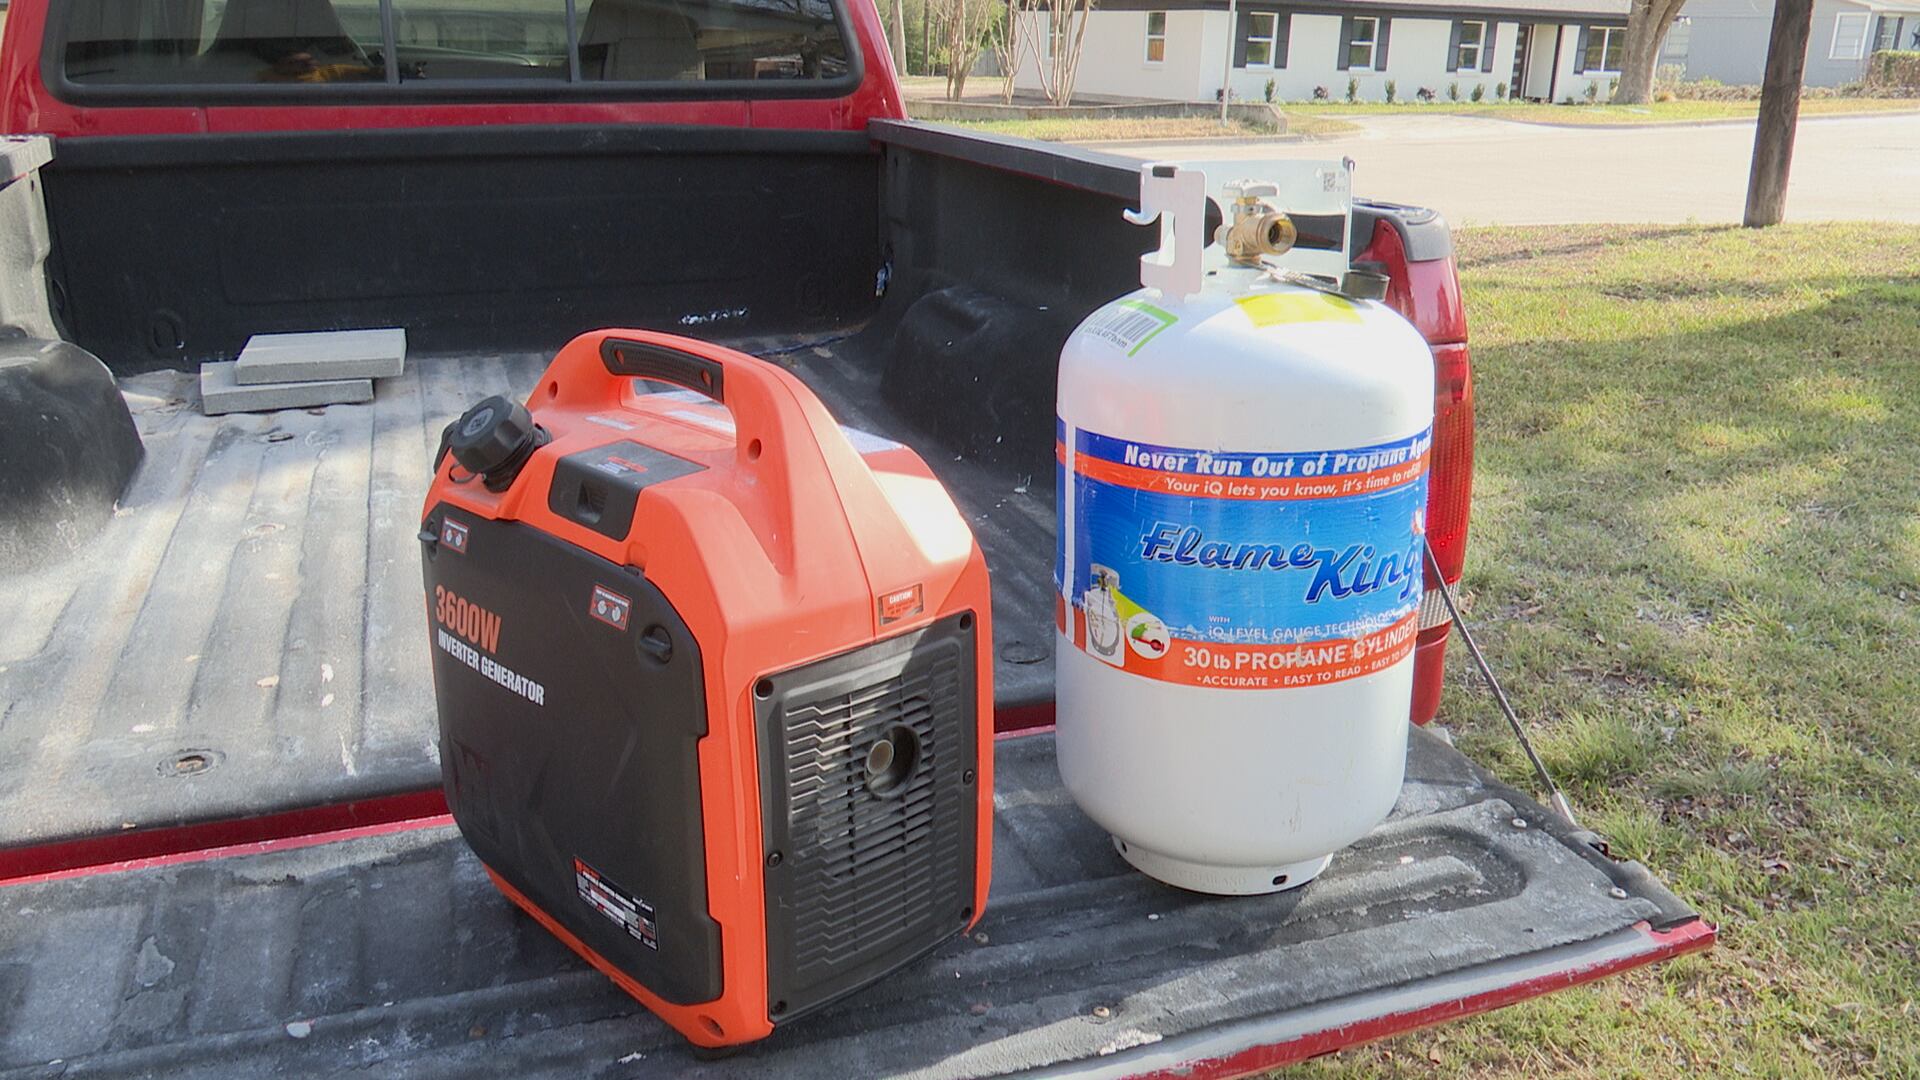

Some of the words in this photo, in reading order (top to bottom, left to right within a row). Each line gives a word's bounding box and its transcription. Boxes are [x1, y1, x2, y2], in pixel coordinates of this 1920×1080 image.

[1124, 444, 1188, 471] Never
[1196, 453, 1243, 475] Run
[1252, 456, 1295, 477] Out
[1302, 453, 1328, 476] of
[1332, 446, 1407, 474] Propane
[1165, 477, 1200, 492] Your
[1204, 481, 1223, 495] iQ
[1228, 482, 1255, 496] lets
[1260, 484, 1289, 499] you
[1294, 482, 1338, 496] know,
[1342, 480, 1362, 493] it's
[1366, 475, 1390, 488] time
[1392, 472, 1401, 483] to
[1141, 520, 1320, 570] Flame
[1303, 544, 1419, 604] King
[436, 584, 502, 655] 3600W
[1208, 615, 1231, 623] WITH
[1208, 625, 1225, 638] iQ
[1229, 627, 1268, 640] LEVEL
[1273, 625, 1323, 639] GAUGE
[1184, 647, 1211, 668] 30
[1213, 654, 1231, 670] lb
[1235, 644, 1348, 670] PROPANE
[1353, 615, 1416, 659] CYLINDER
[438, 628, 480, 671] INVERTER
[481, 655, 545, 706] GENERATOR
[1202, 675, 1268, 686] ACCURATE
[1284, 673, 1312, 685] EASY
[1317, 671, 1331, 682] TO
[1335, 665, 1361, 679] READ
[1371, 655, 1391, 670] EASY
